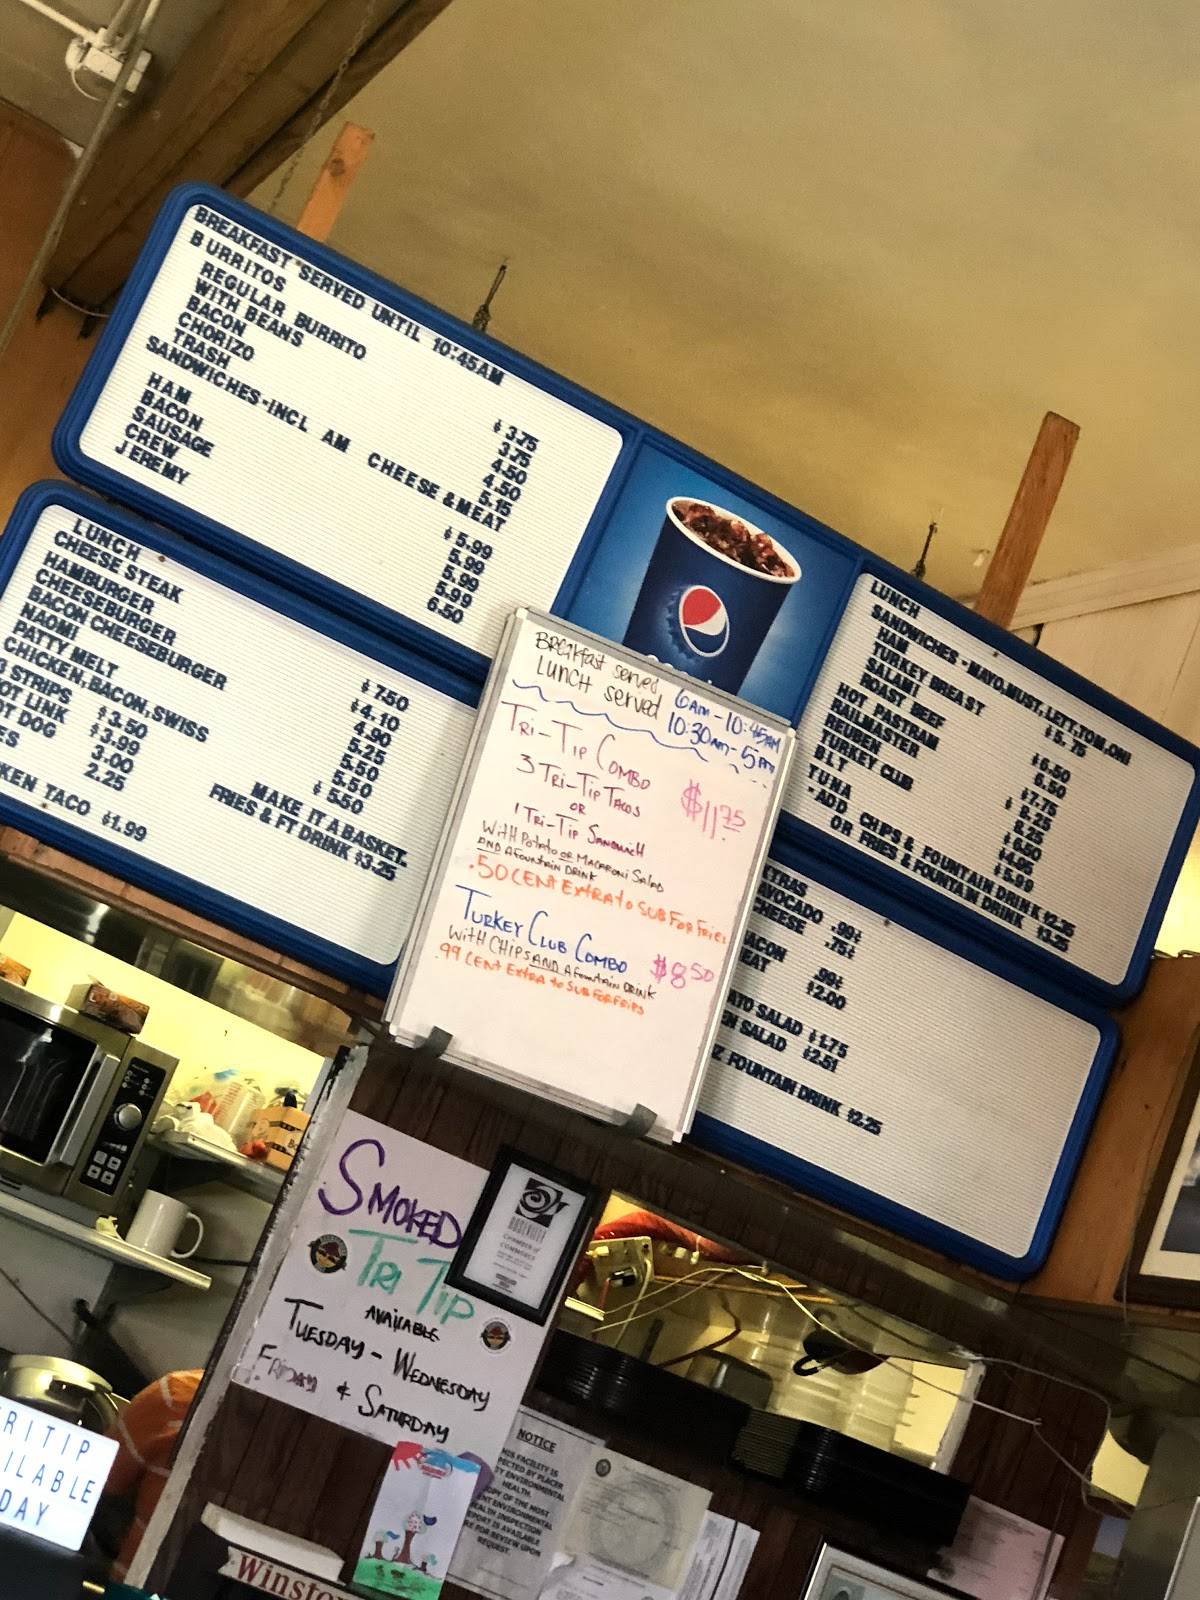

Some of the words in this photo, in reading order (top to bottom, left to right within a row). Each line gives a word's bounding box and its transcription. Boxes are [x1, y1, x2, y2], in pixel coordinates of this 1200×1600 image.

[185, 294, 247, 337] BACON
[193, 205, 294, 269] BREAKFAST
[297, 261, 365, 310] SERVED
[371, 302, 420, 343] UNTIL
[431, 337, 506, 386] 10:45AM
[194, 277, 241, 314] WITH
[243, 304, 304, 347] BEANS
[199, 260, 286, 318] REGULAR
[292, 311, 367, 360] BURRITO
[172, 327, 231, 370] TRASH
[177, 311, 255, 362] CHORIZO
[146, 371, 192, 405] HAM
[131, 405, 215, 458] SAUSAGE
[139, 388, 204, 432] BACON
[114, 439, 191, 485] JEREMY
[124, 422, 180, 460] CREW
[497, 441, 532, 468] 3.75
[320, 428, 351, 453] AM
[367, 452, 440, 500] CHEESE
[490, 458, 527, 485] 4.50
[477, 489, 513, 517] 5.15
[482, 473, 521, 502] 4.50
[71, 517, 142, 562] LUNCH
[42, 550, 154, 615] HAMBURGER
[53, 530, 123, 574] CHEESE
[123, 563, 184, 604] STEAK
[441, 563, 479, 593] 5.99
[447, 547, 485, 576] 5.99
[35, 567, 176, 650] CHEESEBURGER
[426, 595, 464, 624] 6.50
[433, 579, 472, 609] 5.99
[869, 579, 921, 619] LUNCH
[19, 601, 80, 641] NAOMI
[26, 584, 90, 625] BACON
[89, 614, 227, 691] CHEESEBURGER
[870, 603, 959, 665] SANDWICHES
[875, 625, 910, 655] HAM
[11, 618, 70, 655] PATTY
[68, 645, 119, 679] MELT
[871, 640, 930, 683] TURKEY
[9, 664, 72, 705] STRIPS
[603, 674, 662, 720] served
[835, 681, 868, 709] HOT
[864, 656, 921, 698] SALAMI
[23, 691, 70, 724] LINK
[858, 671, 907, 708] ROAST
[908, 700, 947, 730] BEEF
[16, 709, 57, 738] DOG
[353, 720, 392, 748] 4.90
[823, 712, 883, 755] REUBEN
[829, 696, 920, 759] RAILMASTER
[90, 744, 134, 774] 3.00
[338, 752, 379, 782] 5.50
[346, 736, 387, 766] 5.25
[595, 733, 651, 790] COMBO
[819, 727, 879, 771] TURKEY
[879, 762, 914, 792] CLUB
[83, 761, 127, 791] 2.25
[331, 768, 373, 799] 5.50
[516, 753, 535, 774] 3
[602, 785, 640, 818] TACOS
[806, 762, 852, 800] TUNA
[43, 782, 91, 816] TACO
[101, 810, 147, 842] $1.99
[249, 781, 304, 817] MAKE
[305, 807, 327, 827] IT
[568, 802, 585, 815] OR
[208, 782, 258, 817] FRIES
[258, 806, 272, 825] &
[273, 813, 299, 834] FT
[297, 823, 353, 861] DRINK
[353, 849, 398, 882] $3.25
[476, 836, 501, 854] AND
[829, 814, 854, 837] OR
[857, 829, 899, 861] FRIES
[911, 858, 981, 906] FOUNTAIN
[979, 894, 1025, 930] DRINK
[858, 811, 903, 845] CHIPS
[920, 844, 996, 896] FOUNTAIN
[993, 884, 1044, 921] DRINK
[455, 884, 524, 938] TURKEY
[527, 910, 567, 954] CLUB
[574, 932, 627, 973] COMBO
[637, 900, 666, 922] SUB
[738, 1018, 787, 1052] SALAD
[754, 1002, 803, 1037] SALAD
[724, 1050, 798, 1096] FOUNTAIN
[796, 1084, 843, 1117] DRINK
[318, 1138, 463, 1248] SMOKED
[284, 1297, 366, 1360] TUESDAY
[392, 1347, 490, 1412] WEDNESDAY
[0, 1407, 90, 1461] RITIP
[357, 1383, 450, 1444] SATURDAY
[517, 1428, 557, 1453] NOTICE
